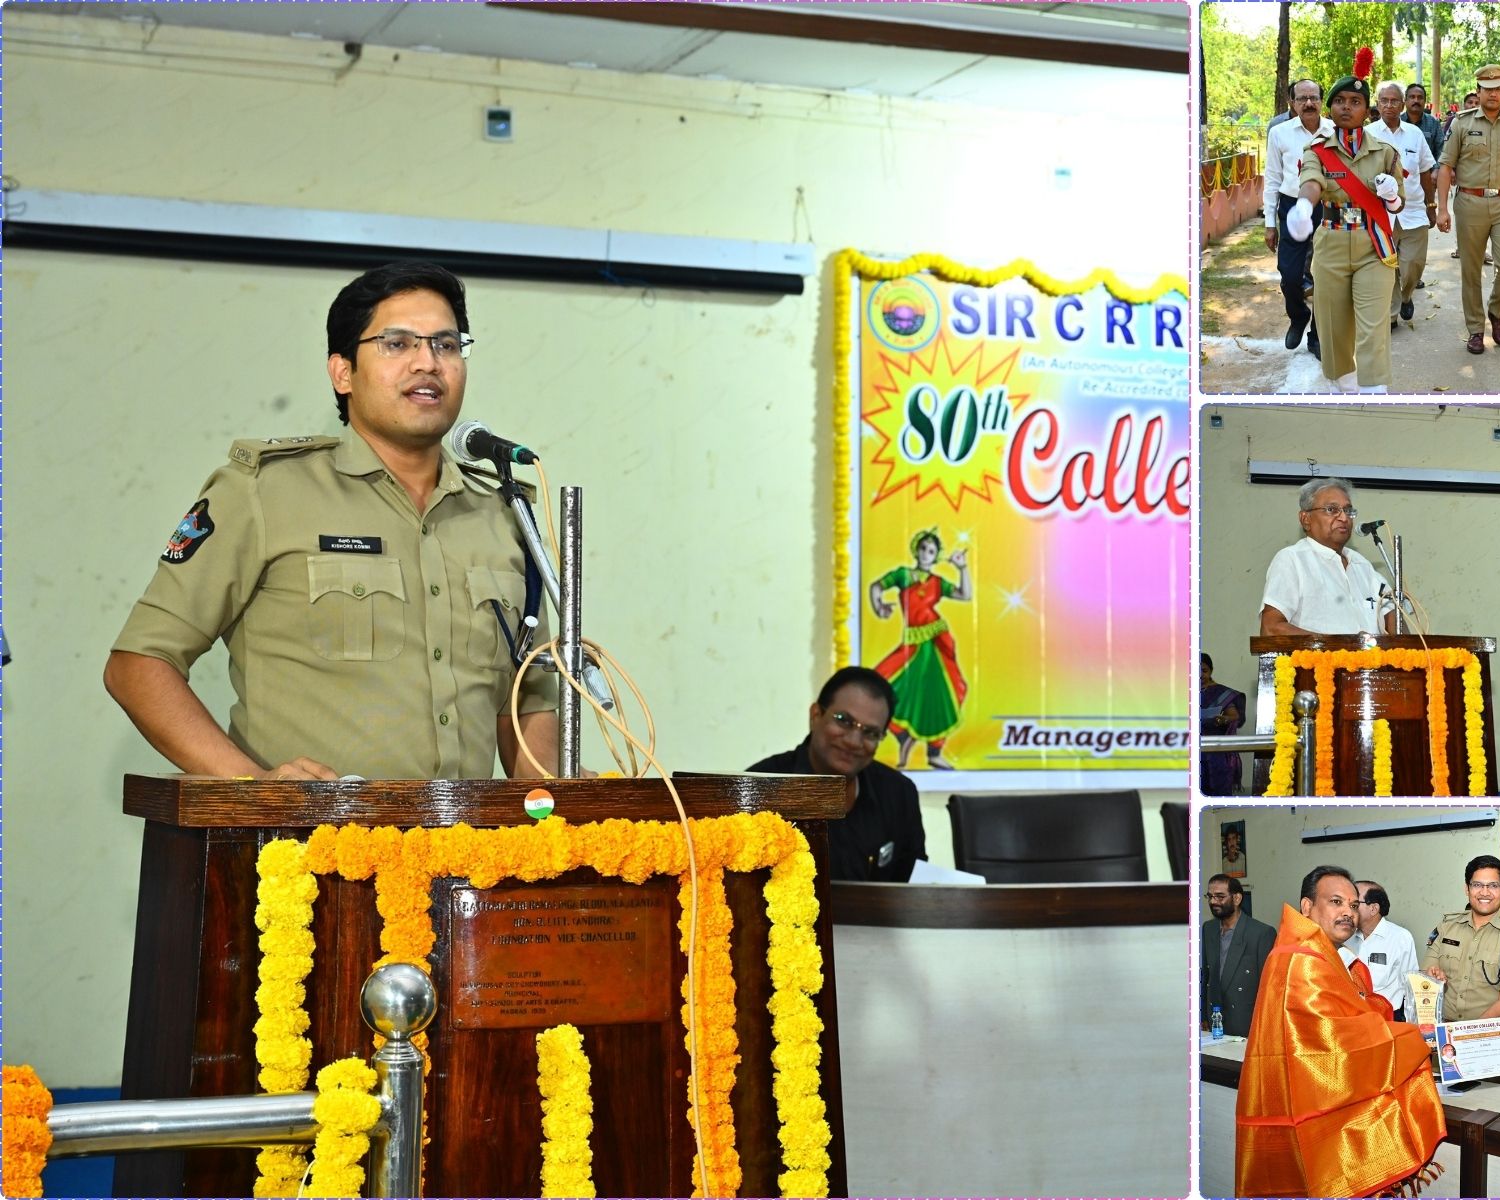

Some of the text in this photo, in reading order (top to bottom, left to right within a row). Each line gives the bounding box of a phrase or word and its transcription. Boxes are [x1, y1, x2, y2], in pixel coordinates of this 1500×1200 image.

[952, 286, 1037, 338] SIR
[1055, 299, 1086, 342] C
[1106, 301, 1135, 345] R
[1050, 358, 1134, 374] Autonomous
[1138, 363, 1185, 379] College
[901, 384, 1009, 462] 80th
